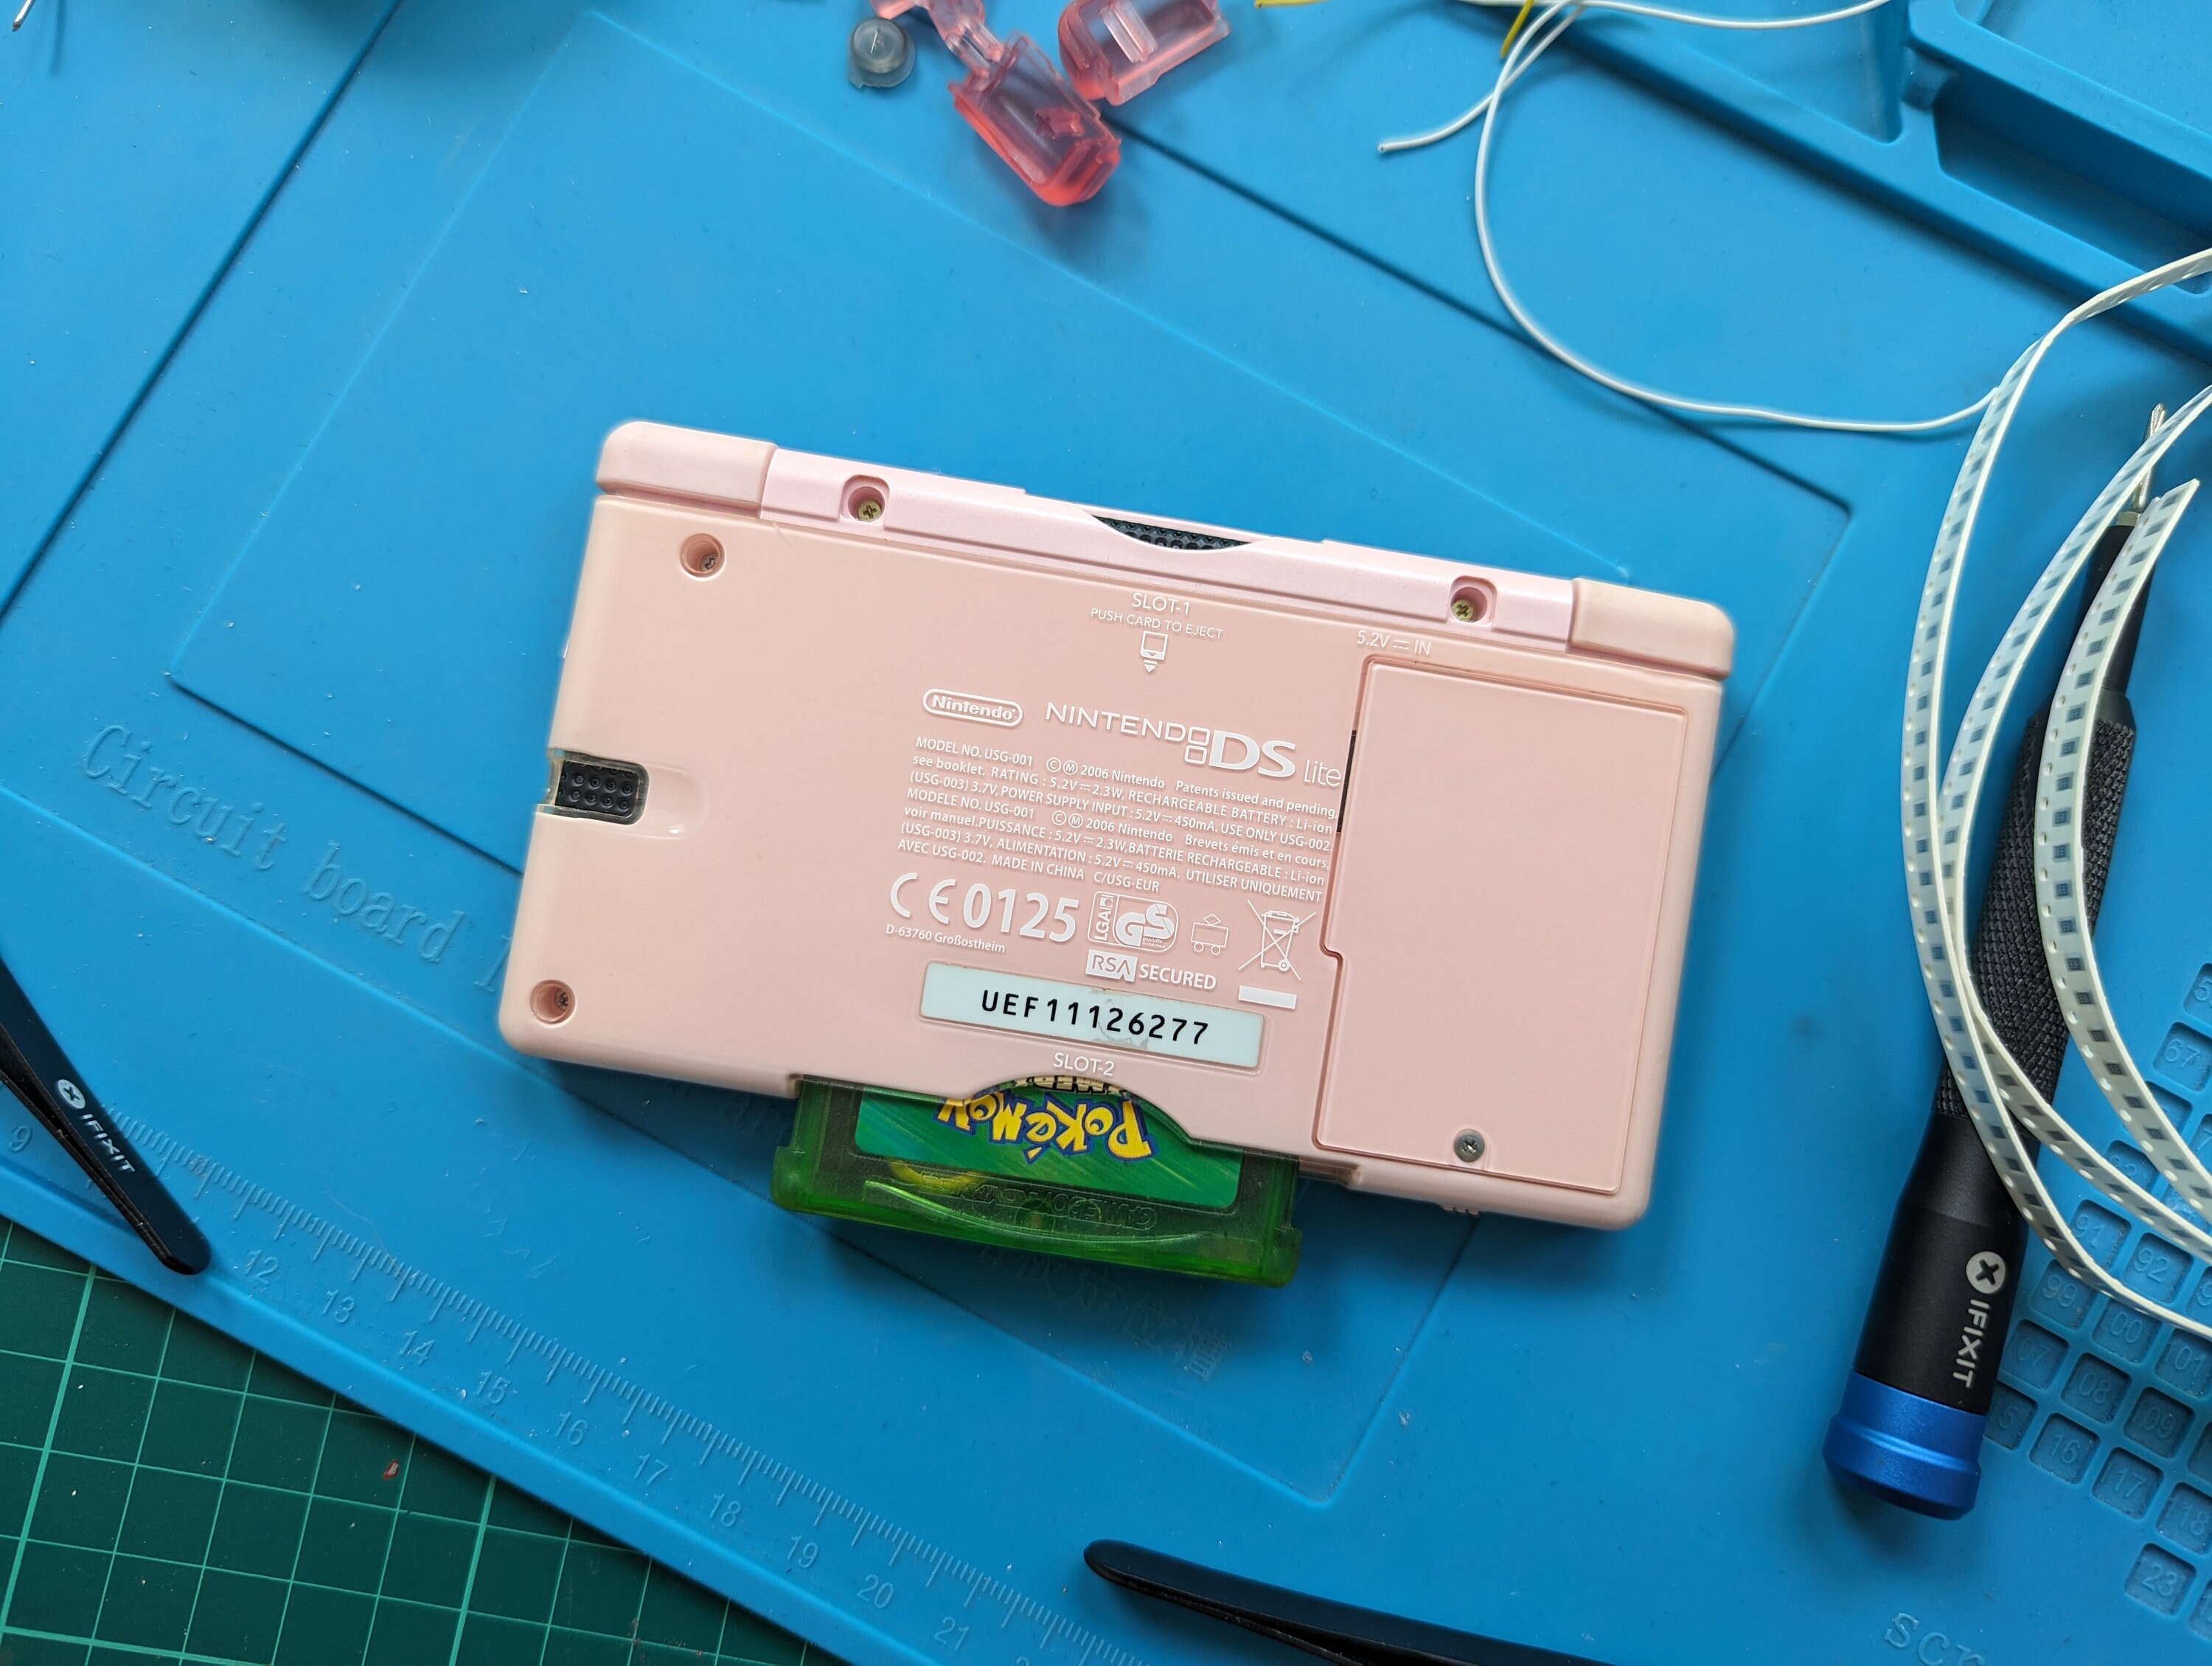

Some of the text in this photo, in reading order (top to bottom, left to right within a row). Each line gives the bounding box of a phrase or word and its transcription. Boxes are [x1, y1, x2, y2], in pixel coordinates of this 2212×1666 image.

[1132, 593, 1190, 616] SLOT-1
[1091, 607, 1224, 639] PUSH CARD TO EJECT
[1356, 629, 1431, 656] 5.2V IN
[931, 694, 1017, 722] Nintendo
[1208, 729, 1295, 777] DS
[913, 756, 933, 767] see
[936, 757, 985, 776] booklet.
[991, 766, 1039, 785] RATING
[1049, 777, 1078, 791] 5.2V
[1091, 784, 1124, 801] 2.3W,
[1128, 789, 1228, 816] RECHARGEABLE
[1231, 807, 1287, 826] BATTERY
[1296, 818, 1332, 834] Li-ion
[916, 736, 959, 754] MODEL
[961, 743, 982, 757] NO.
[984, 748, 1032, 766] USG-001
[1080, 764, 1109, 779] 2006
[1111, 769, 1165, 788] Nintendo
[1175, 780, 1220, 797] Patents
[1222, 788, 1259, 805] issued
[1261, 797, 1284, 809] and
[1286, 802, 1338, 820] pending,
[906, 787, 958, 806] MODELE
[960, 796, 981, 810] NO.
[984, 800, 1034, 819] USG-001
[1085, 817, 1115, 832] 2006
[1118, 822, 1173, 841] Nintendo
[1185, 833, 1228, 851] Brevets
[1231, 840, 1259, 857] émis
[1262, 849, 1275, 859] et
[1277, 852, 1292, 862] en
[1295, 855, 1329, 870] cours,
[910, 770, 969, 791] (USG-003)
[971, 780, 998, 797] 3.7V,
[1001, 785, 1043, 803] POWER
[1046, 793, 1090, 811] SUPPLY
[1091, 800, 1128, 816] INPUT
[1135, 808, 1162, 822] 5.2V
[1174, 815, 1218, 833] 450mA.
[1220, 822, 1244, 836] USE
[1245, 827, 1278, 842] ONLY
[1279, 832, 1333, 852] USG-002.
[83, 724, 287, 871] Circuit
[302, 841, 465, 963] board
[901, 821, 961, 843] (USG-003)
[964, 832, 993, 849] 3.7V,
[996, 837, 1086, 862] ALIMENTATION
[1093, 854, 1121, 868] 5.2V
[1135, 861, 1180, 878] 450mA.
[1186, 869, 1238, 888] UTILISER
[1241, 878, 1323, 902] UNIQUEMENT
[904, 806, 928, 818] voir
[1054, 830, 1082, 844] 5.2V
[1187, 851, 1282, 878] RECHARGEABLE
[1290, 869, 1324, 885] Li-ion
[897, 839, 1160, 892] AVEC USG-002. MADE IN CHINA C/USG-EUR
[963, 883, 1079, 942] 0125
[886, 923, 1005, 953] D-63760 Großostheim
[1092, 954, 1217, 990] RSA SECURED
[981, 989, 1210, 1045] UEF11126277
[1053, 1052, 1116, 1077] SLOT-2
[2164, 1038, 2202, 1069] 67
[9, 1125, 32, 1152] 9
[80, 1114, 135, 1172] IFIXIT
[2073, 1213, 2107, 1249] 91
[245, 1249, 280, 1285] 12
[2133, 1248, 2170, 1284] 92
[322, 1288, 355, 1325] 13
[2042, 1274, 2077, 1308] 99
[399, 1329, 436, 1365] 14
[1952, 1299, 1990, 1388] IFIXIT
[476, 1370, 512, 1405] 15
[554, 1410, 590, 1446] 16
[633, 1453, 669, 1486] 17
[709, 1492, 742, 1528] 18
[786, 1533, 820, 1569] 19
[855, 1573, 894, 1609] 20
[933, 1616, 970, 1651] 21
